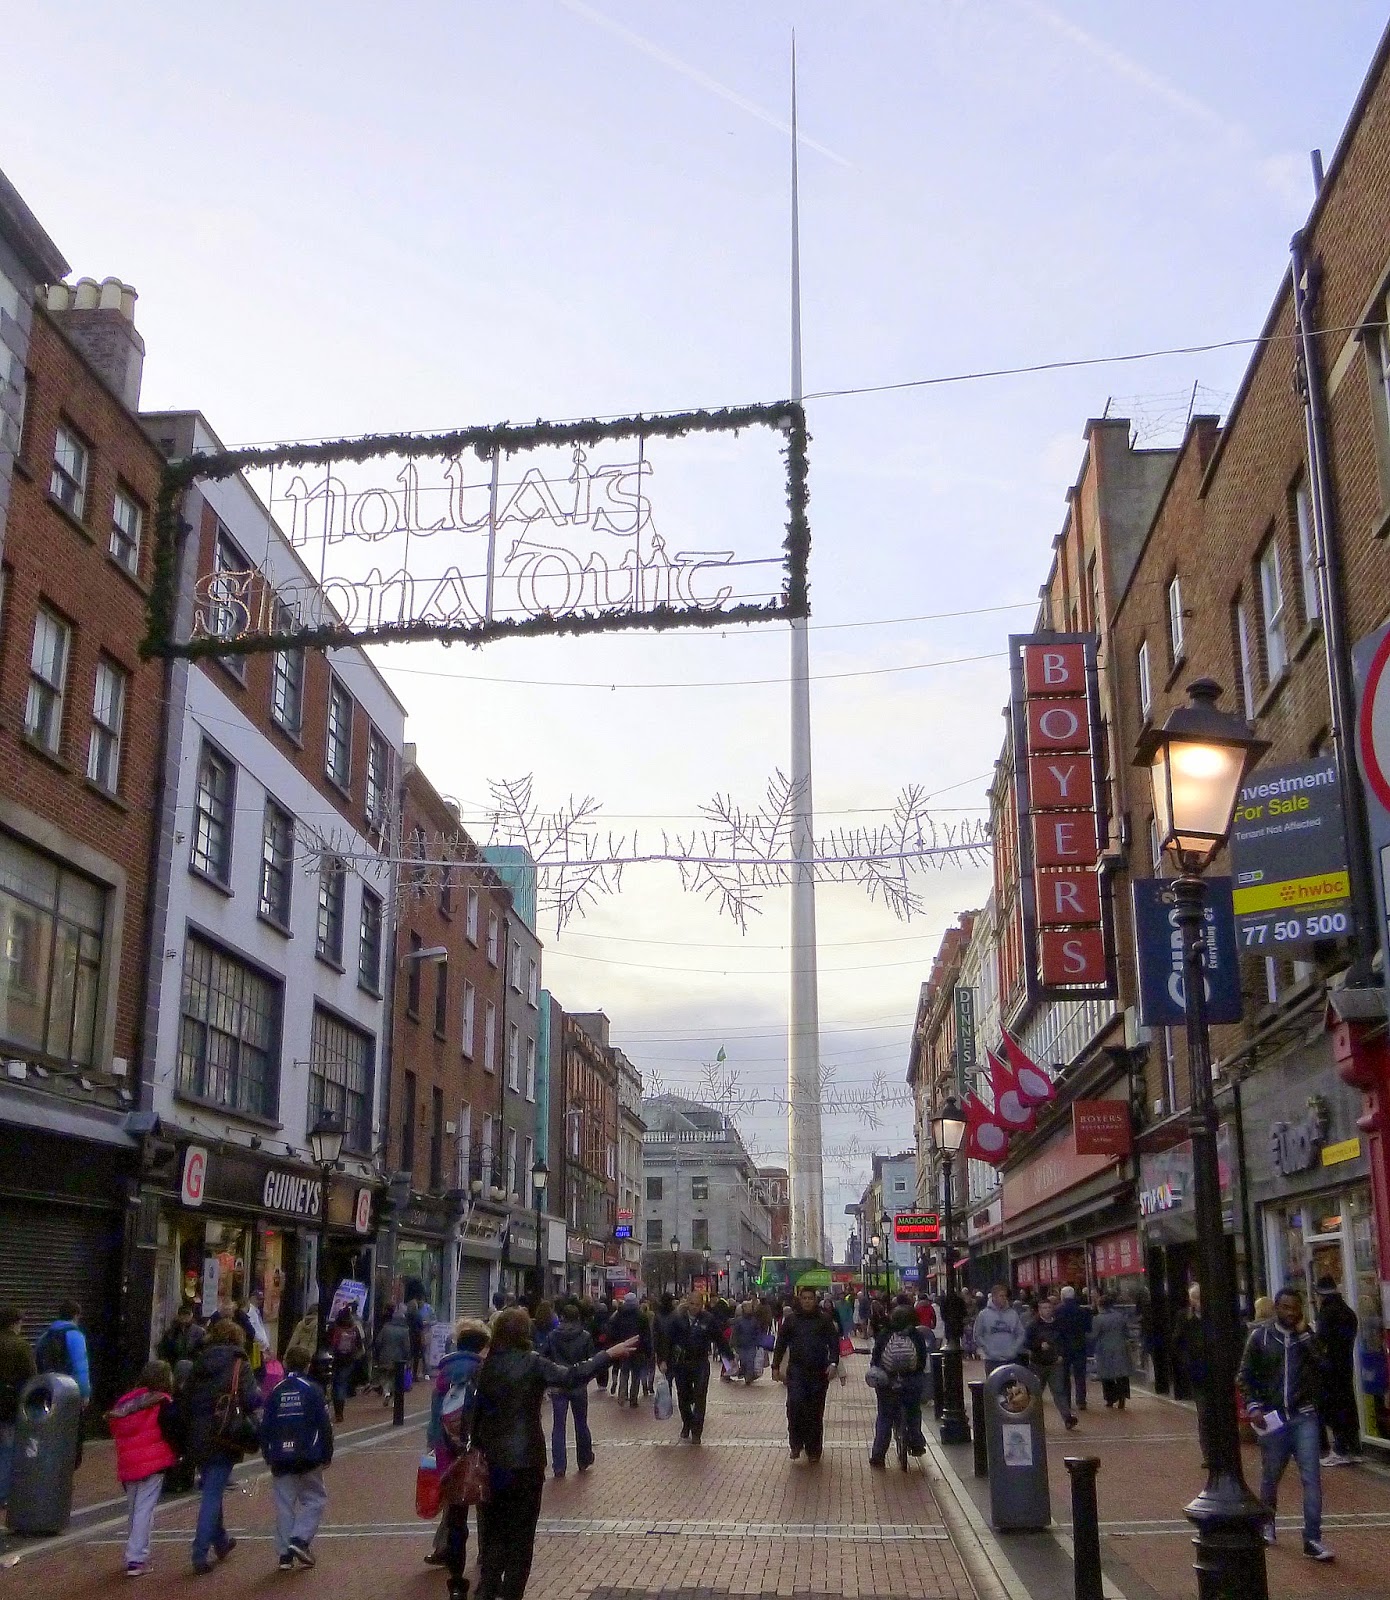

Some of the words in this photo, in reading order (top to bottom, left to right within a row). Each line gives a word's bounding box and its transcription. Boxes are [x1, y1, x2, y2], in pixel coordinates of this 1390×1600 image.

[1238, 767, 1335, 802] nvestment
[1040, 653, 1088, 974] BOYERS
[1233, 805, 1263, 823] For
[1268, 796, 1310, 817] Sale
[1235, 829, 1265, 842] Tenant
[1266, 825, 1282, 836] Not
[1284, 817, 1321, 832] Affected
[1298, 879, 1344, 898] hwbc
[1242, 924, 1268, 945] 77
[1274, 920, 1300, 941] 50
[1306, 912, 1347, 936] 500
[1206, 925, 1218, 969] Everything
[960, 990, 972, 1062] DUNNES
[1080, 1114, 1122, 1123] BOYERS
[187, 1153, 203, 1198] G
[263, 1170, 322, 1215] GUINEYS
[357, 1193, 369, 1227] G
[897, 1217, 935, 1225] MADIGANS
